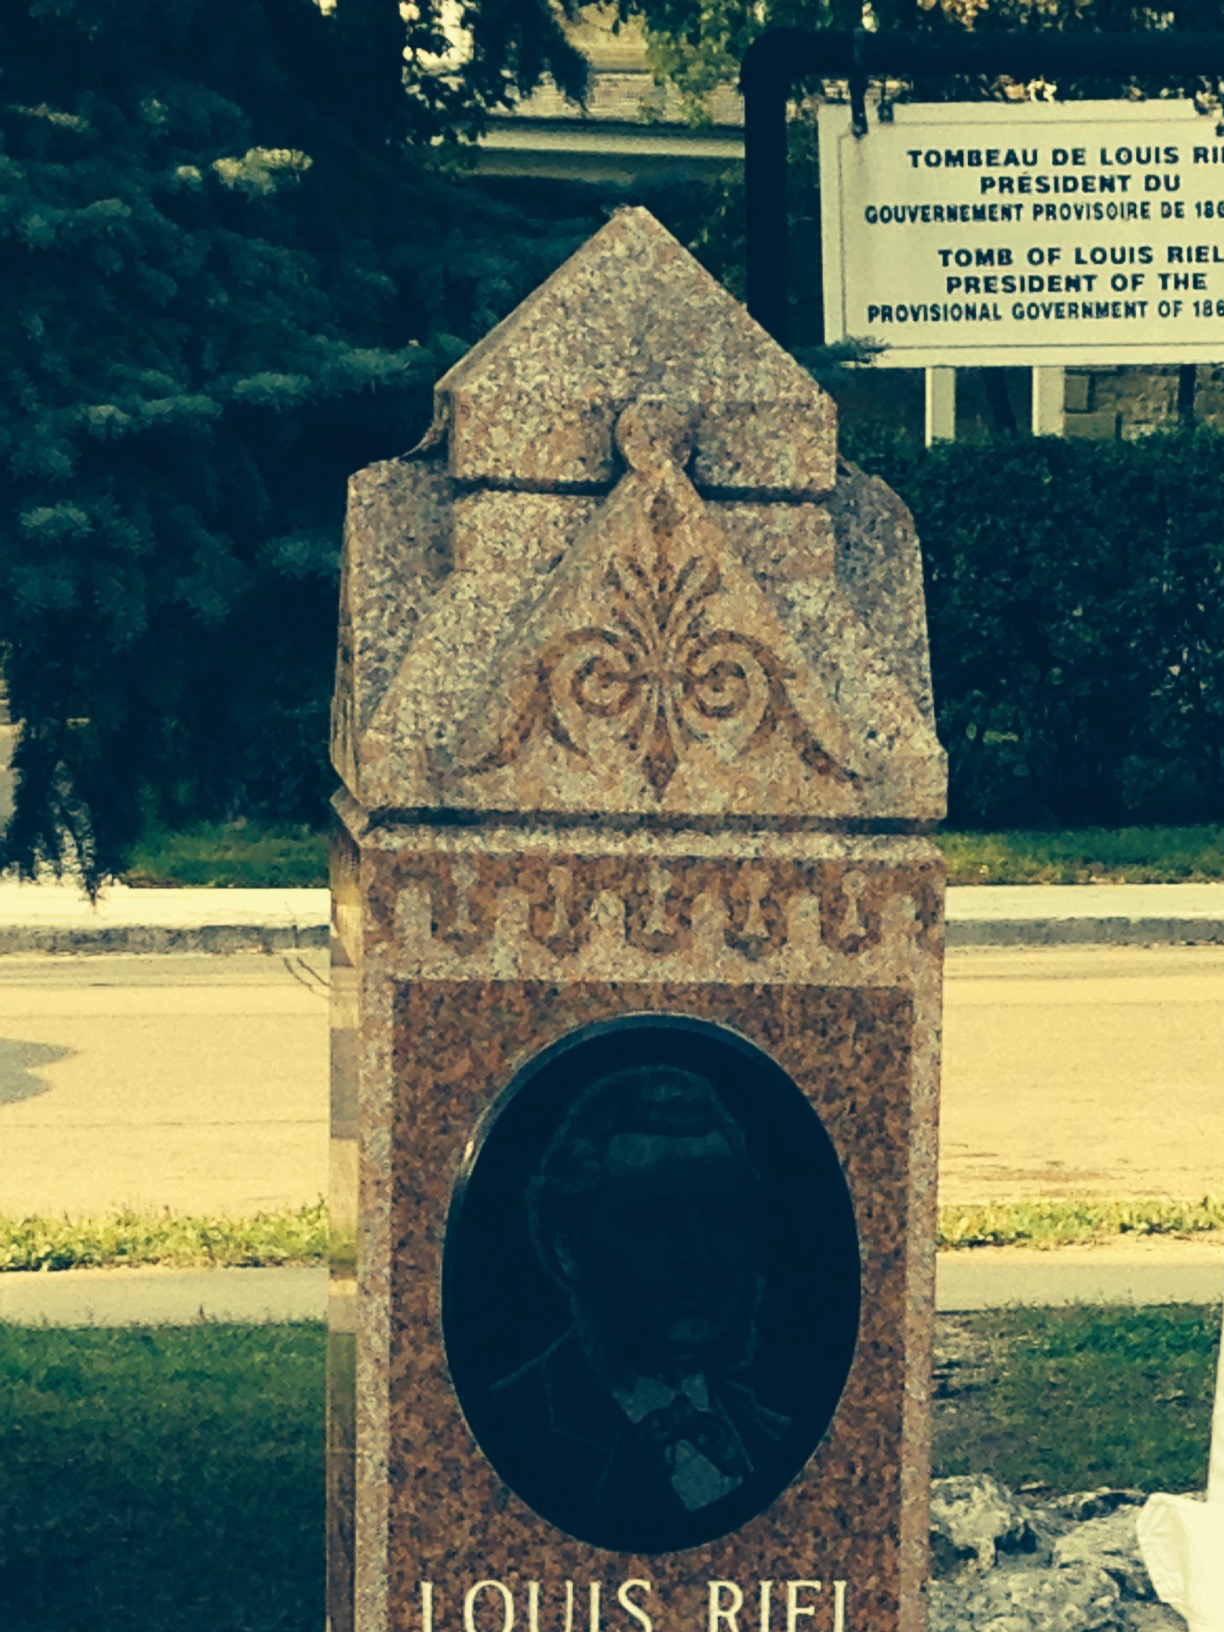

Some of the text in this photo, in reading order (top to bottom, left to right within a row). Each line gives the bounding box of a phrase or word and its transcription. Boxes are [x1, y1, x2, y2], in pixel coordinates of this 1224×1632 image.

[906, 148, 1038, 169] TOMBEAU
[1051, 147, 1086, 167] DE
[1100, 146, 1179, 166] LOUIS
[1144, 174, 1181, 192] DU
[864, 203, 1024, 225] GOUVERNEMENT
[1032, 201, 1151, 221] PROVISOIRE
[1160, 201, 1185, 219] DE
[937, 248, 1013, 268] TOMB
[1026, 247, 1061, 267] OF
[1074, 245, 1154, 265] LOUIS
[946, 272, 1207, 295] PRESIDENT OF THE
[867, 302, 1002, 324] PROVISIONAL
[1011, 300, 1148, 321] GOVERNMENT
[1157, 300, 1183, 318] OF
